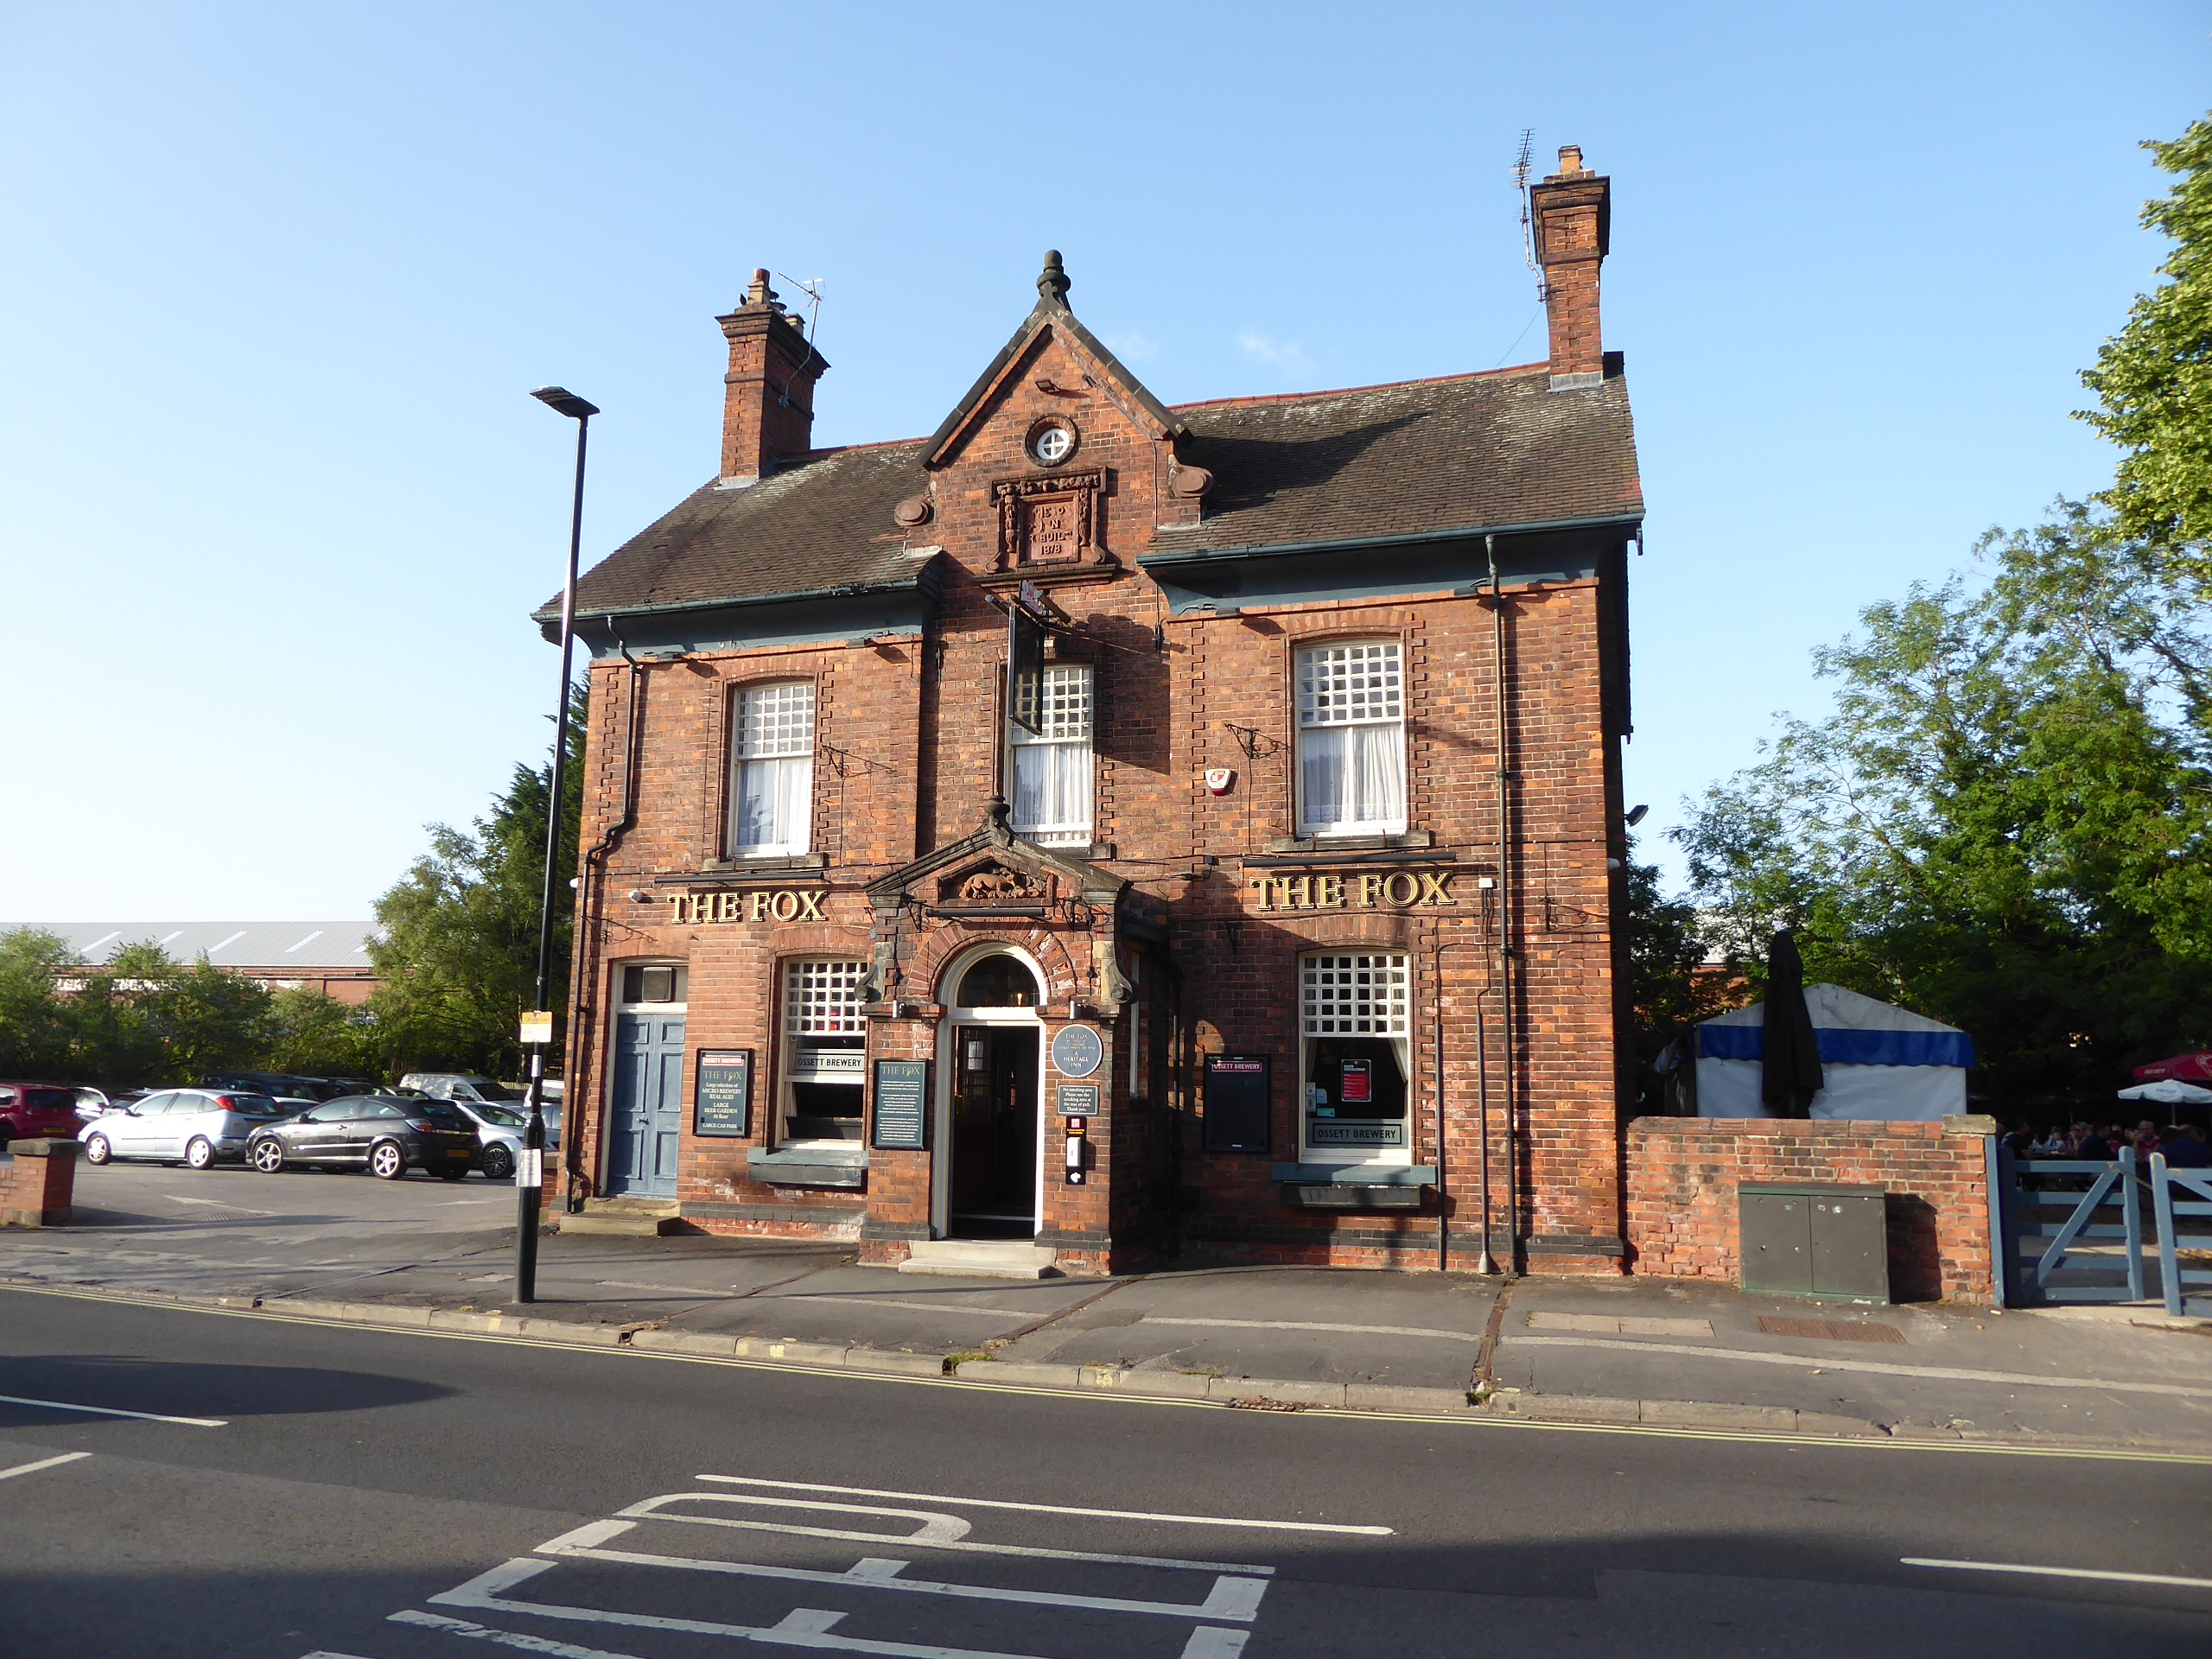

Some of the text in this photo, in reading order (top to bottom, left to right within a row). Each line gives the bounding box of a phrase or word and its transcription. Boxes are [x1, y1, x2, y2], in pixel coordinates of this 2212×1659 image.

[1040, 543, 1062, 556] 1878
[1249, 870, 1454, 911] THE FOX
[667, 889, 827, 924] THE FOX
[798, 1058, 861, 1067] OSSETT BREWERY
[703, 1071, 742, 1082] THE FOX
[881, 1066, 920, 1077] THE FOX
[1318, 1128, 1396, 1139] OSSETT BREWERY
